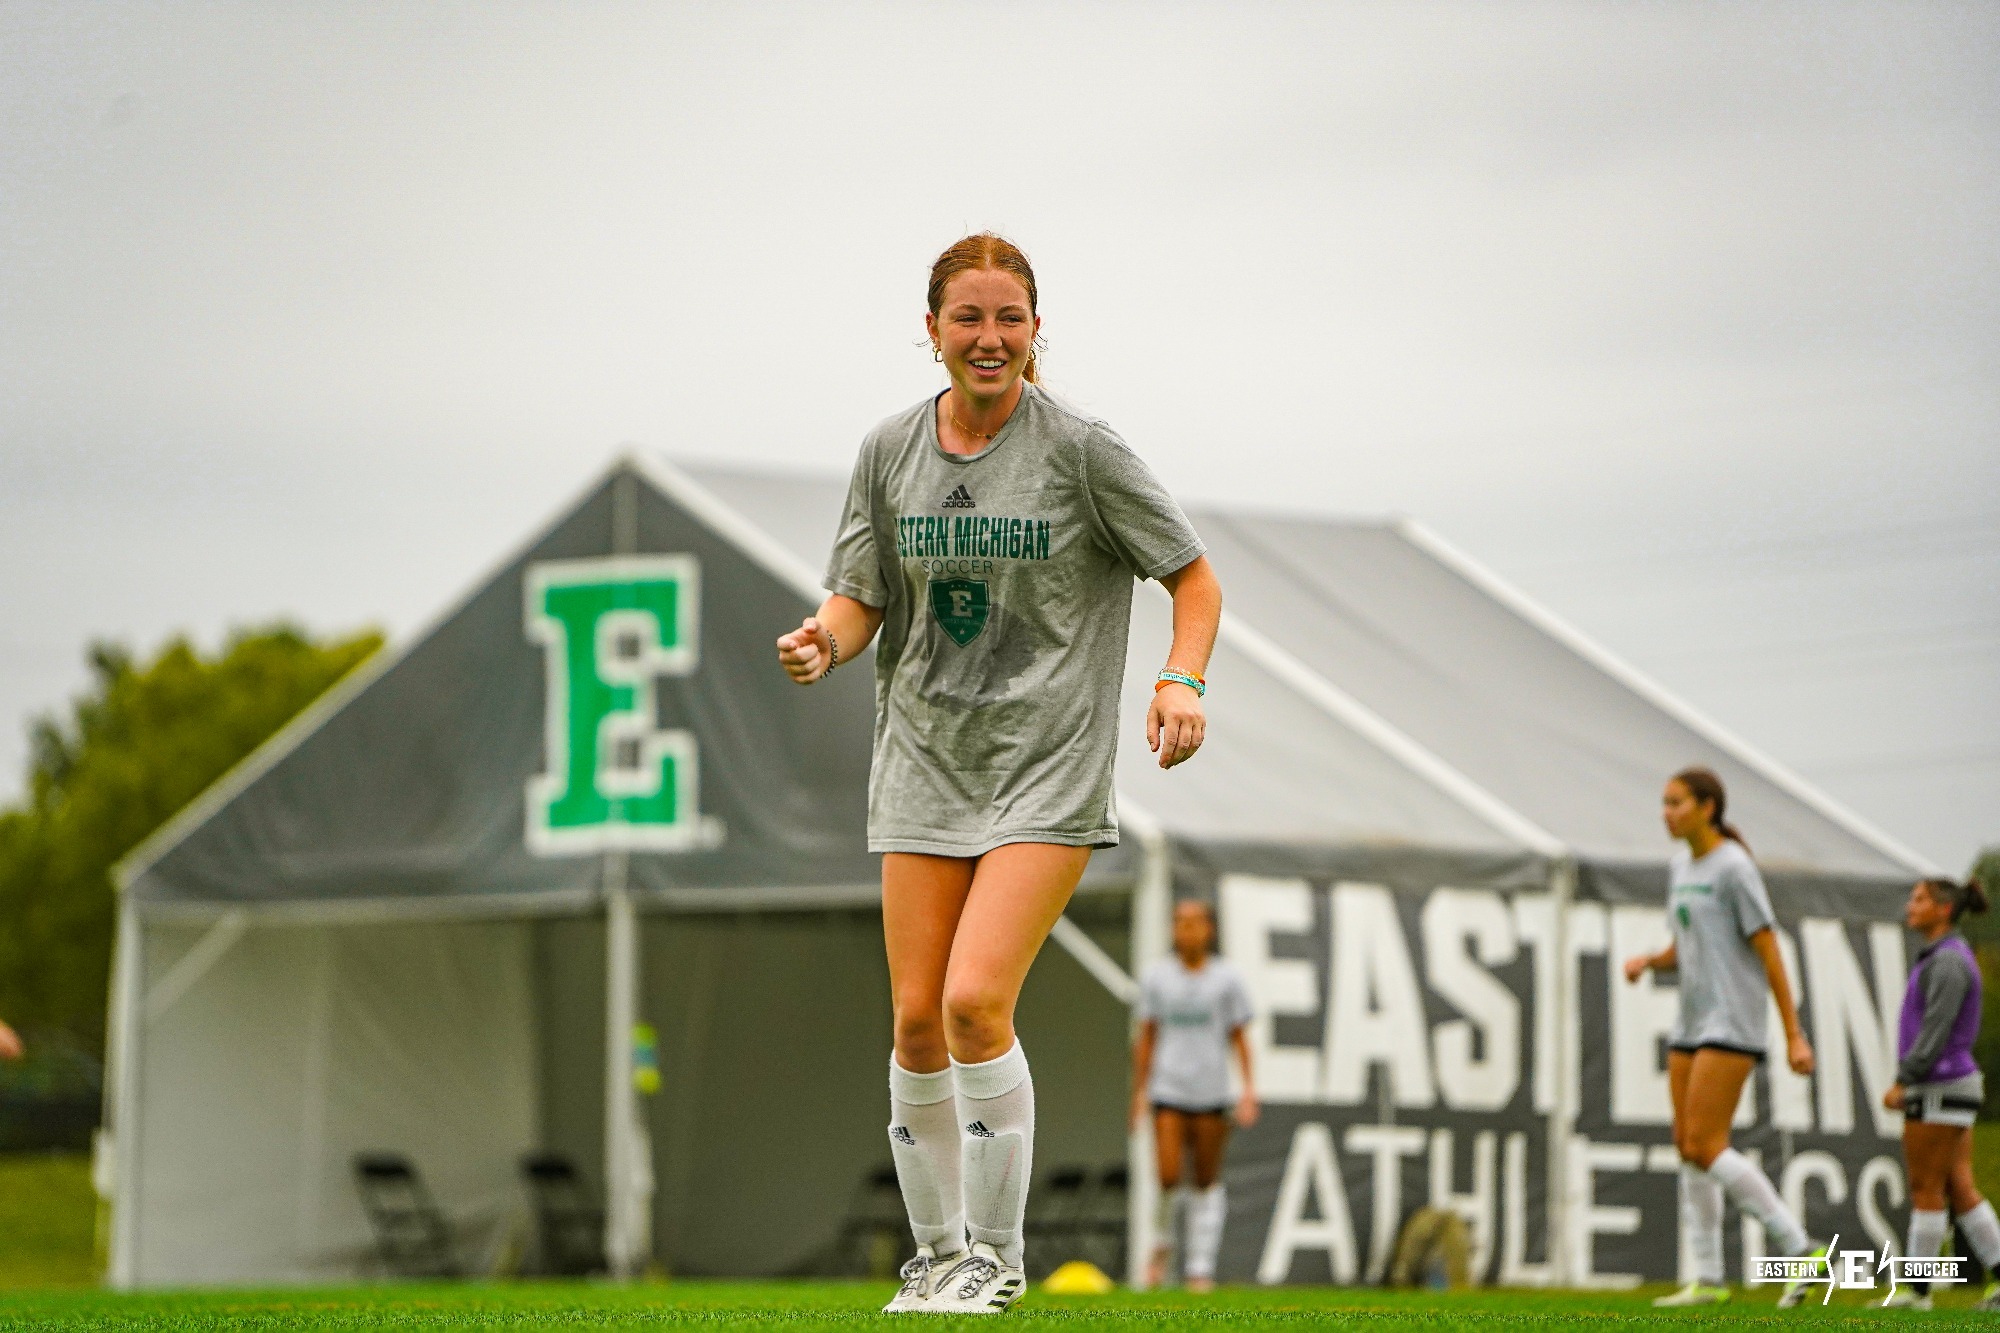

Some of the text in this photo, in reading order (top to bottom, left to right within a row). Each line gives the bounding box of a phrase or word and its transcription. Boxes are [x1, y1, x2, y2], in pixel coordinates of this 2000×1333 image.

[941, 498, 976, 508] adidas
[893, 516, 1050, 561] STERN MICHIGAN
[921, 559, 994, 575] SOCCER
[948, 590, 973, 618] E
[523, 556, 700, 856] E
[965, 1125, 995, 1137] adidas
